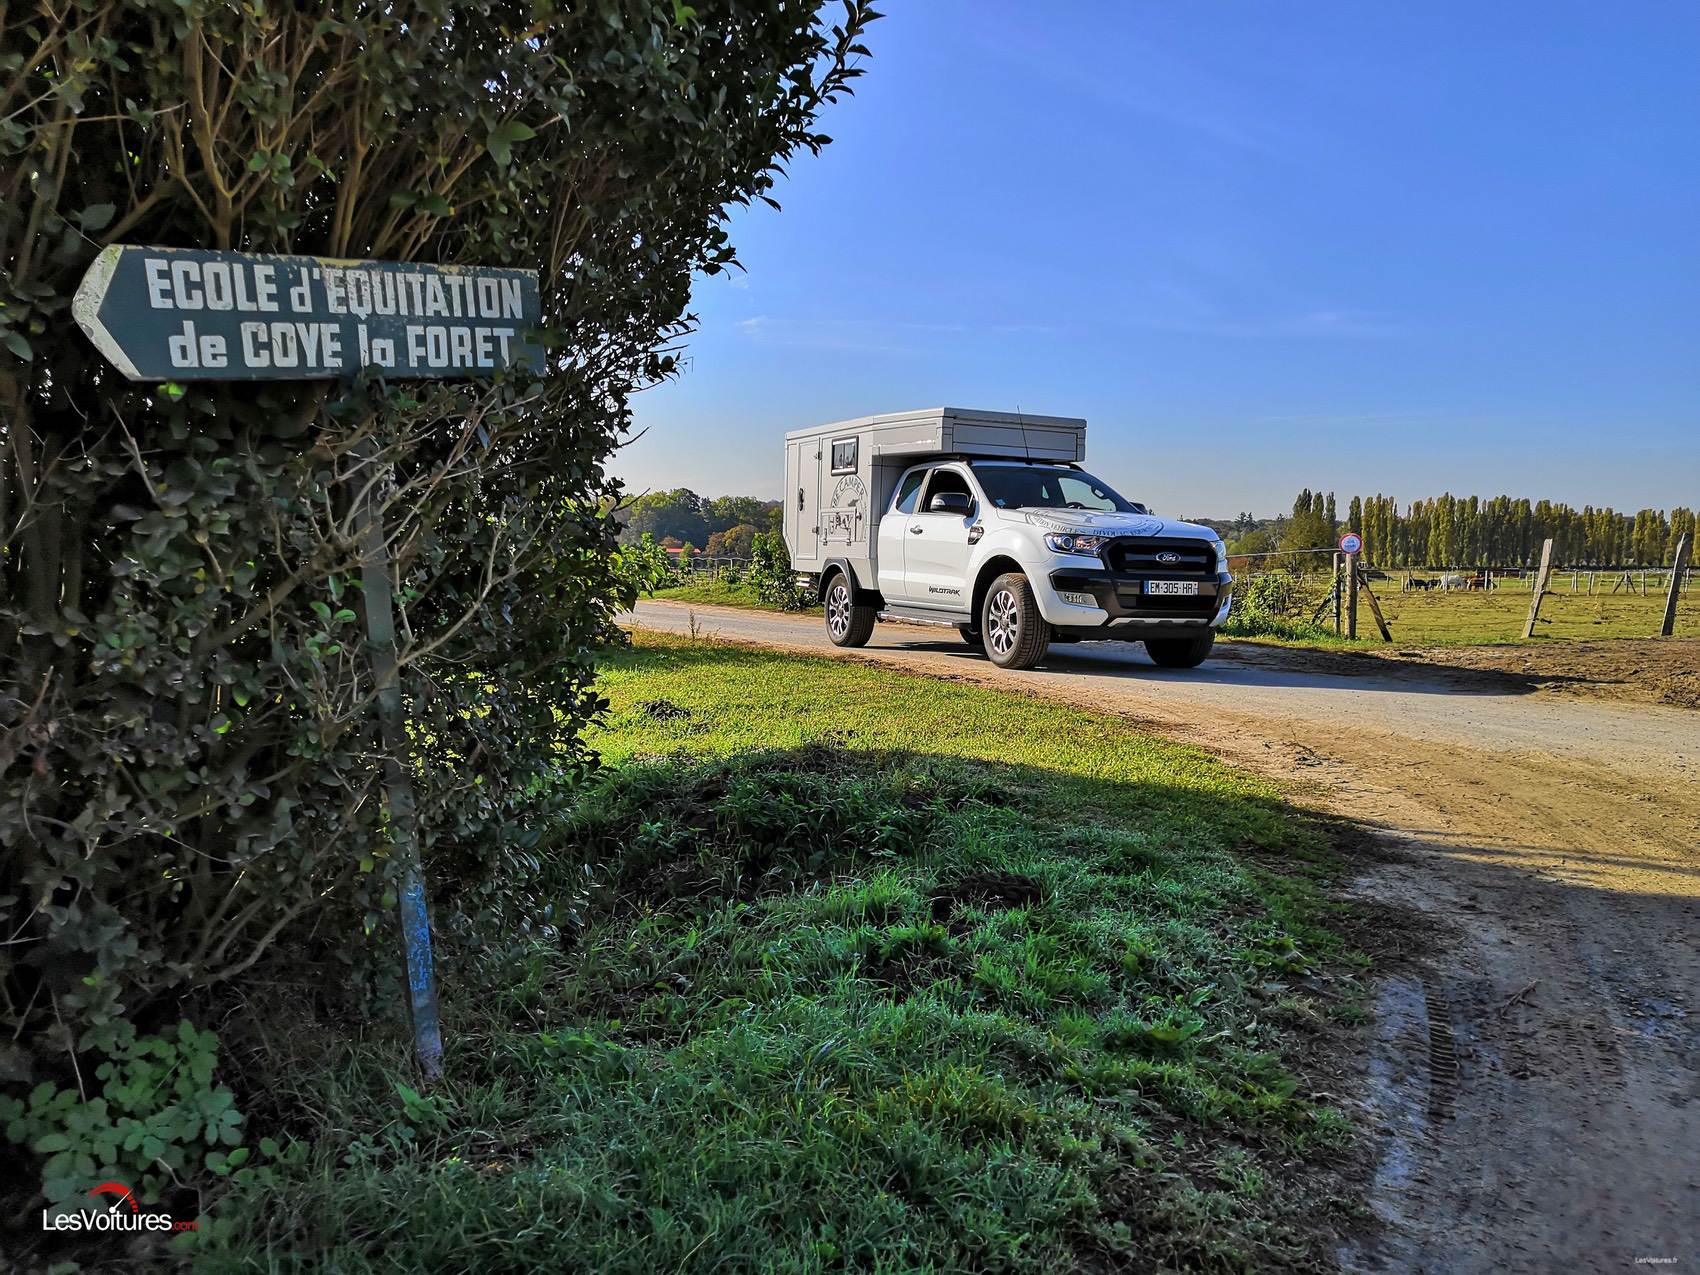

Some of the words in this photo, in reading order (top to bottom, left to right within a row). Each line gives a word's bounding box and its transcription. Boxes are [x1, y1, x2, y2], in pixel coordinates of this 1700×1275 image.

[144, 258, 278, 312] ECOLE
[289, 267, 523, 321] d'EQUITATION
[168, 321, 228, 368] de
[240, 322, 343, 368] COYE
[358, 324, 396, 369] la
[407, 325, 515, 369] FORET
[929, 586, 961, 597] WILDTRAK
